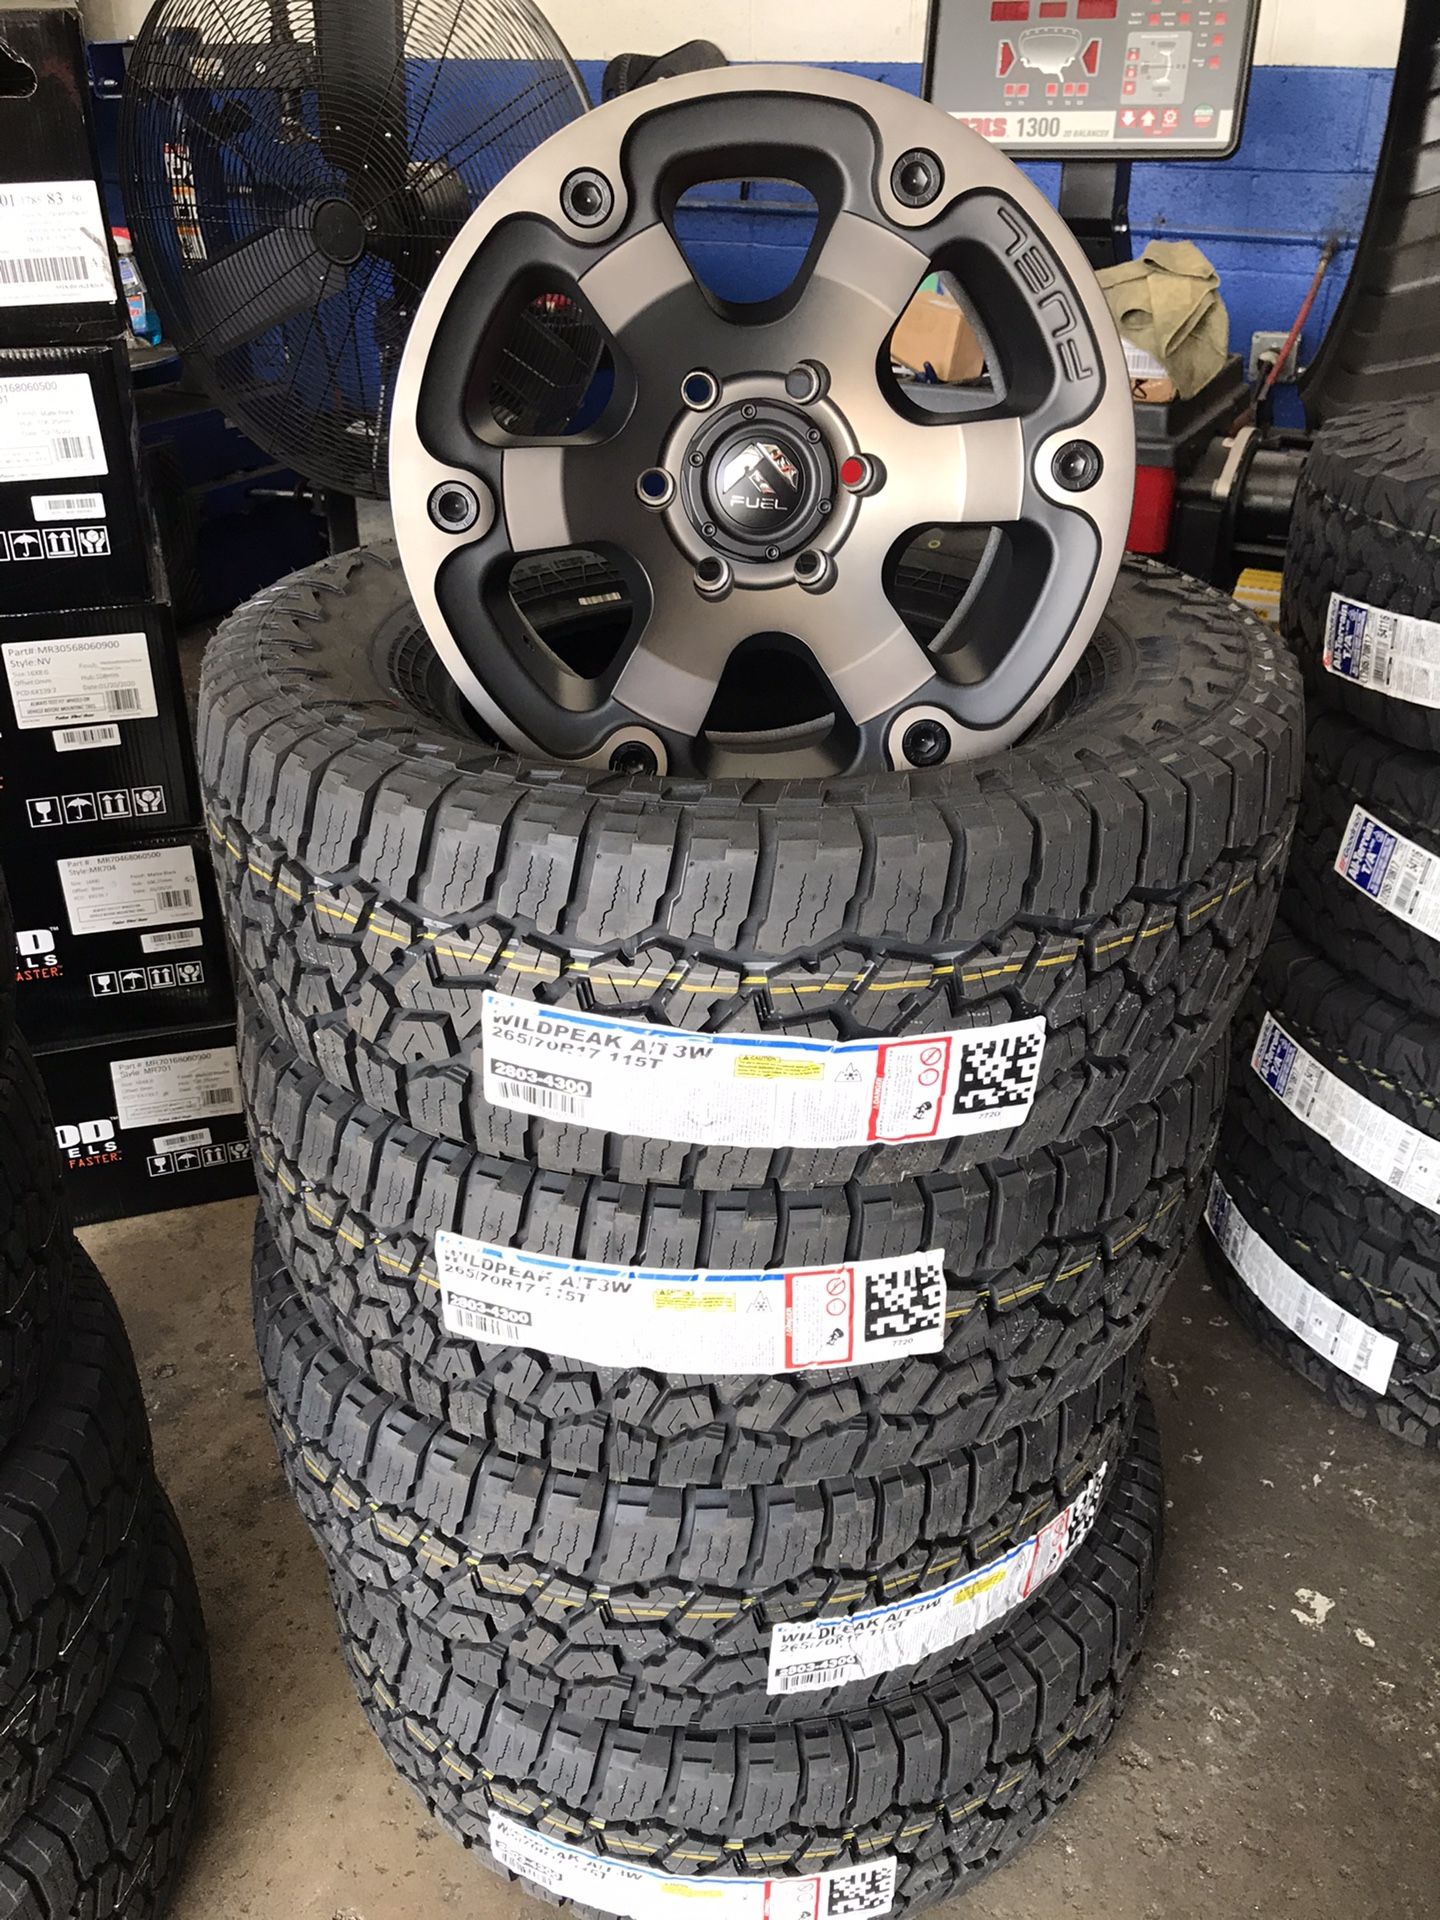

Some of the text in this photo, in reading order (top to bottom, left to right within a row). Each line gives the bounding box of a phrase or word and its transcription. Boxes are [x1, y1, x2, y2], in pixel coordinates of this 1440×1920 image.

[1017, 117, 1061, 137] 1300
[997, 205, 1093, 382] FUEL
[730, 495, 788, 511] FUEL
[16, 967, 63, 982] ASTER.
[493, 1012, 624, 1049] WILDPEAK
[610, 1053, 663, 1069] 115T
[892, 1338, 913, 1346] 7720
